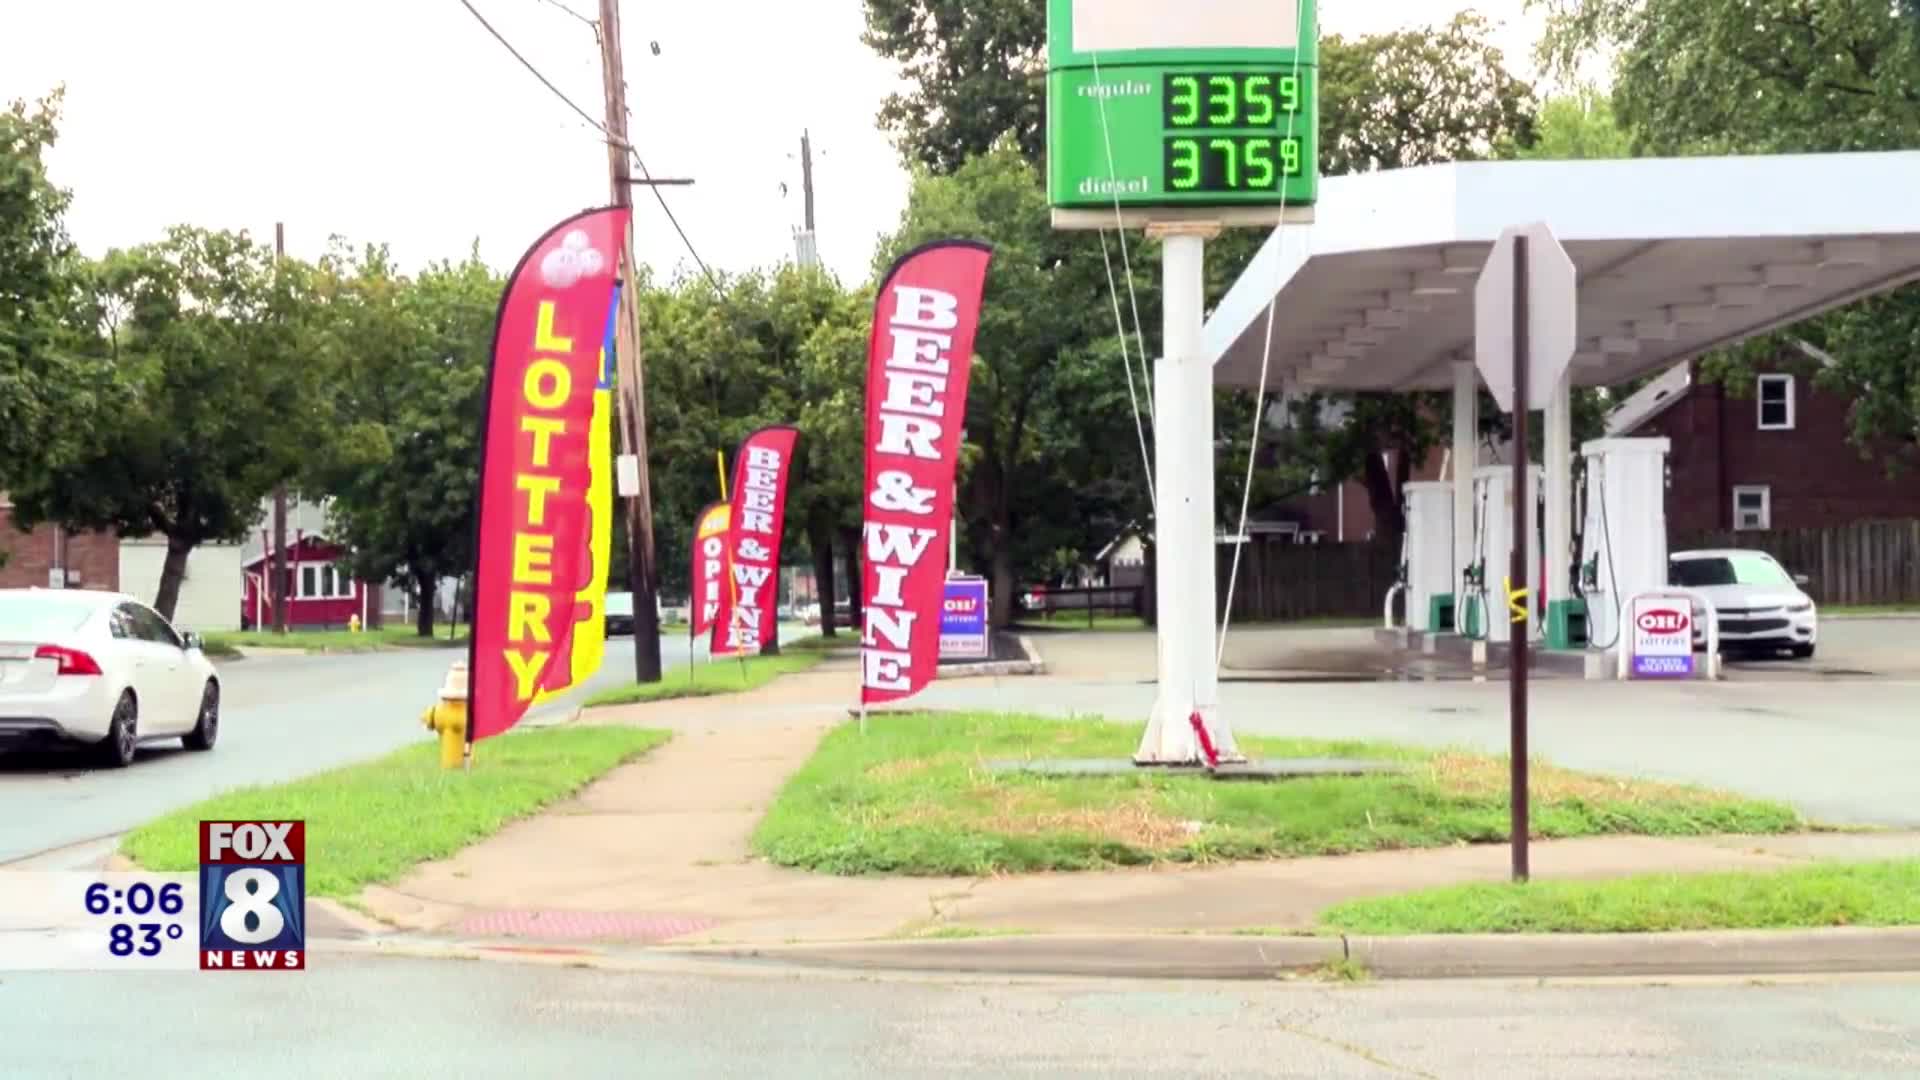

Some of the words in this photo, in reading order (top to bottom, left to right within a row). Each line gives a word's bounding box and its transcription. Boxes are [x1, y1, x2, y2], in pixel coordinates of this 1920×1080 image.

[1077, 80, 1151, 99] regular
[1079, 177, 1148, 195] diesel
[875, 285, 958, 459] BEER
[503, 300, 574, 703] LOTTERY
[740, 445, 781, 534] BEER
[869, 469, 937, 514] &
[702, 536, 723, 624] OPEN
[737, 537, 770, 562] &
[725, 564, 772, 650] WINE
[862, 520, 937, 693] WINE
